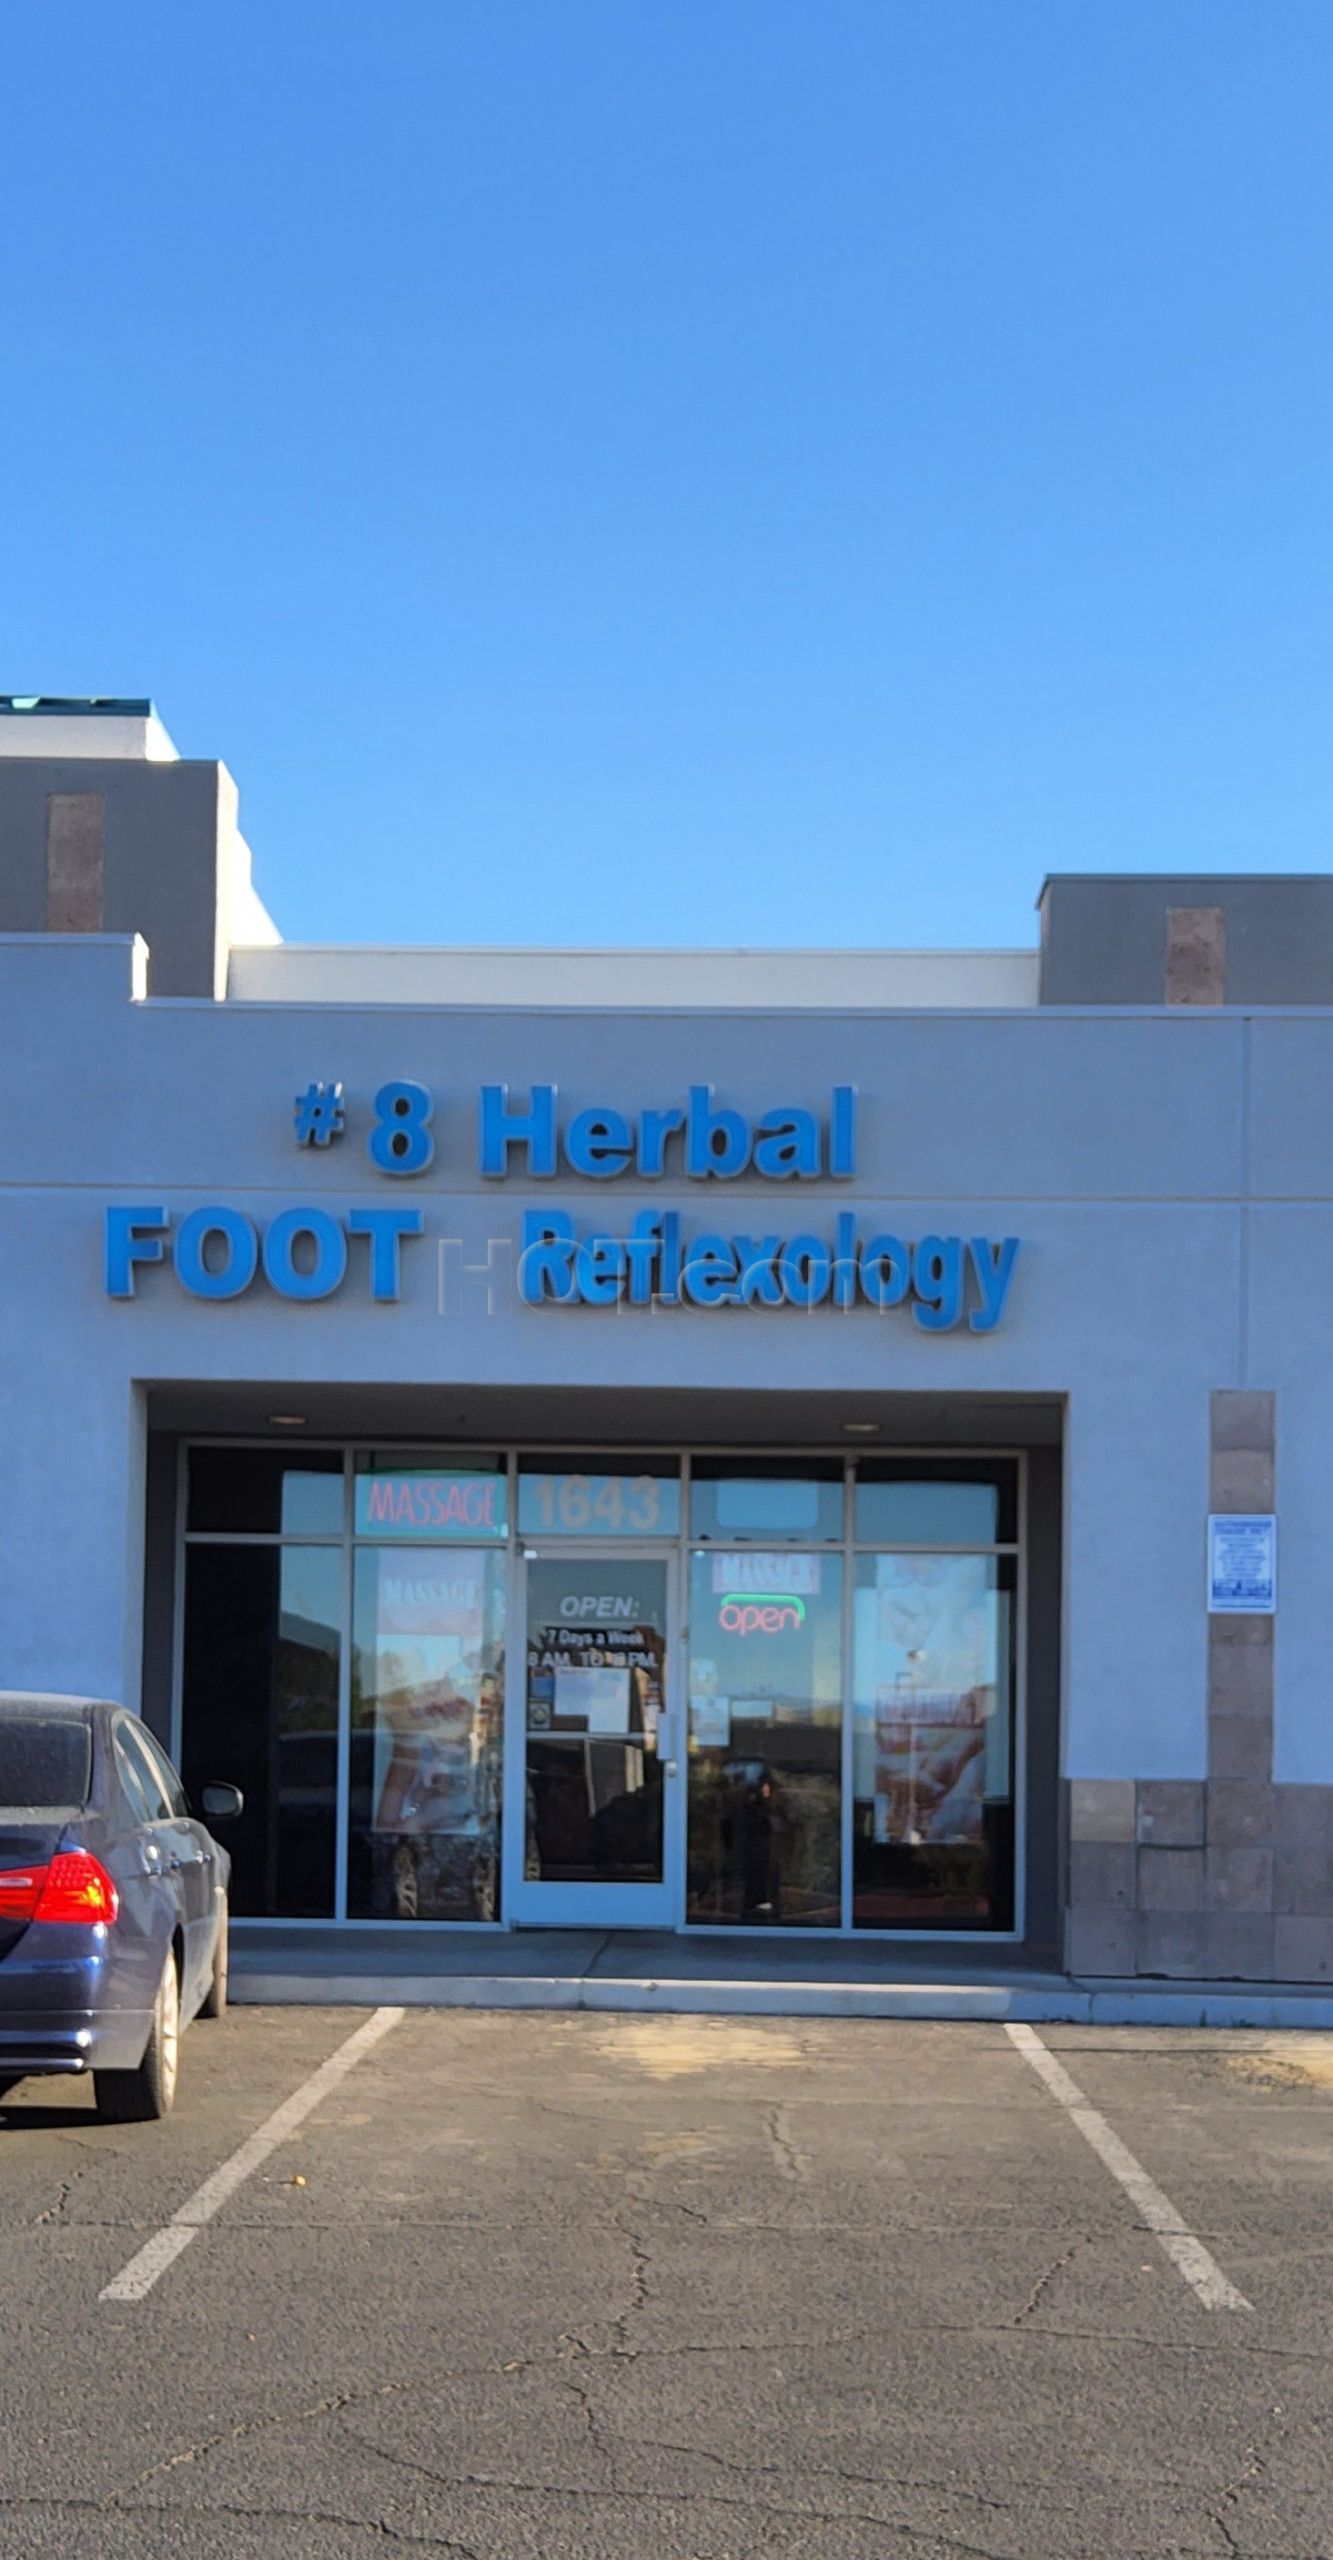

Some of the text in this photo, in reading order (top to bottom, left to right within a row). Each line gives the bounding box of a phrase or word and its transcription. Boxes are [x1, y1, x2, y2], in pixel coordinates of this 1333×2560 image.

[367, 1080, 434, 1176] 8
[478, 1083, 859, 1178] Herbal
[105, 1205, 1021, 1333] FOOT Reflexology
[367, 1480, 497, 1526] MASSAGE
[534, 1475, 660, 1530] 1643
[559, 1595, 640, 1618] OPEN:
[719, 1605, 800, 1637] open
[559, 1630, 593, 1646] Days
[579, 1651, 604, 1666] TO
